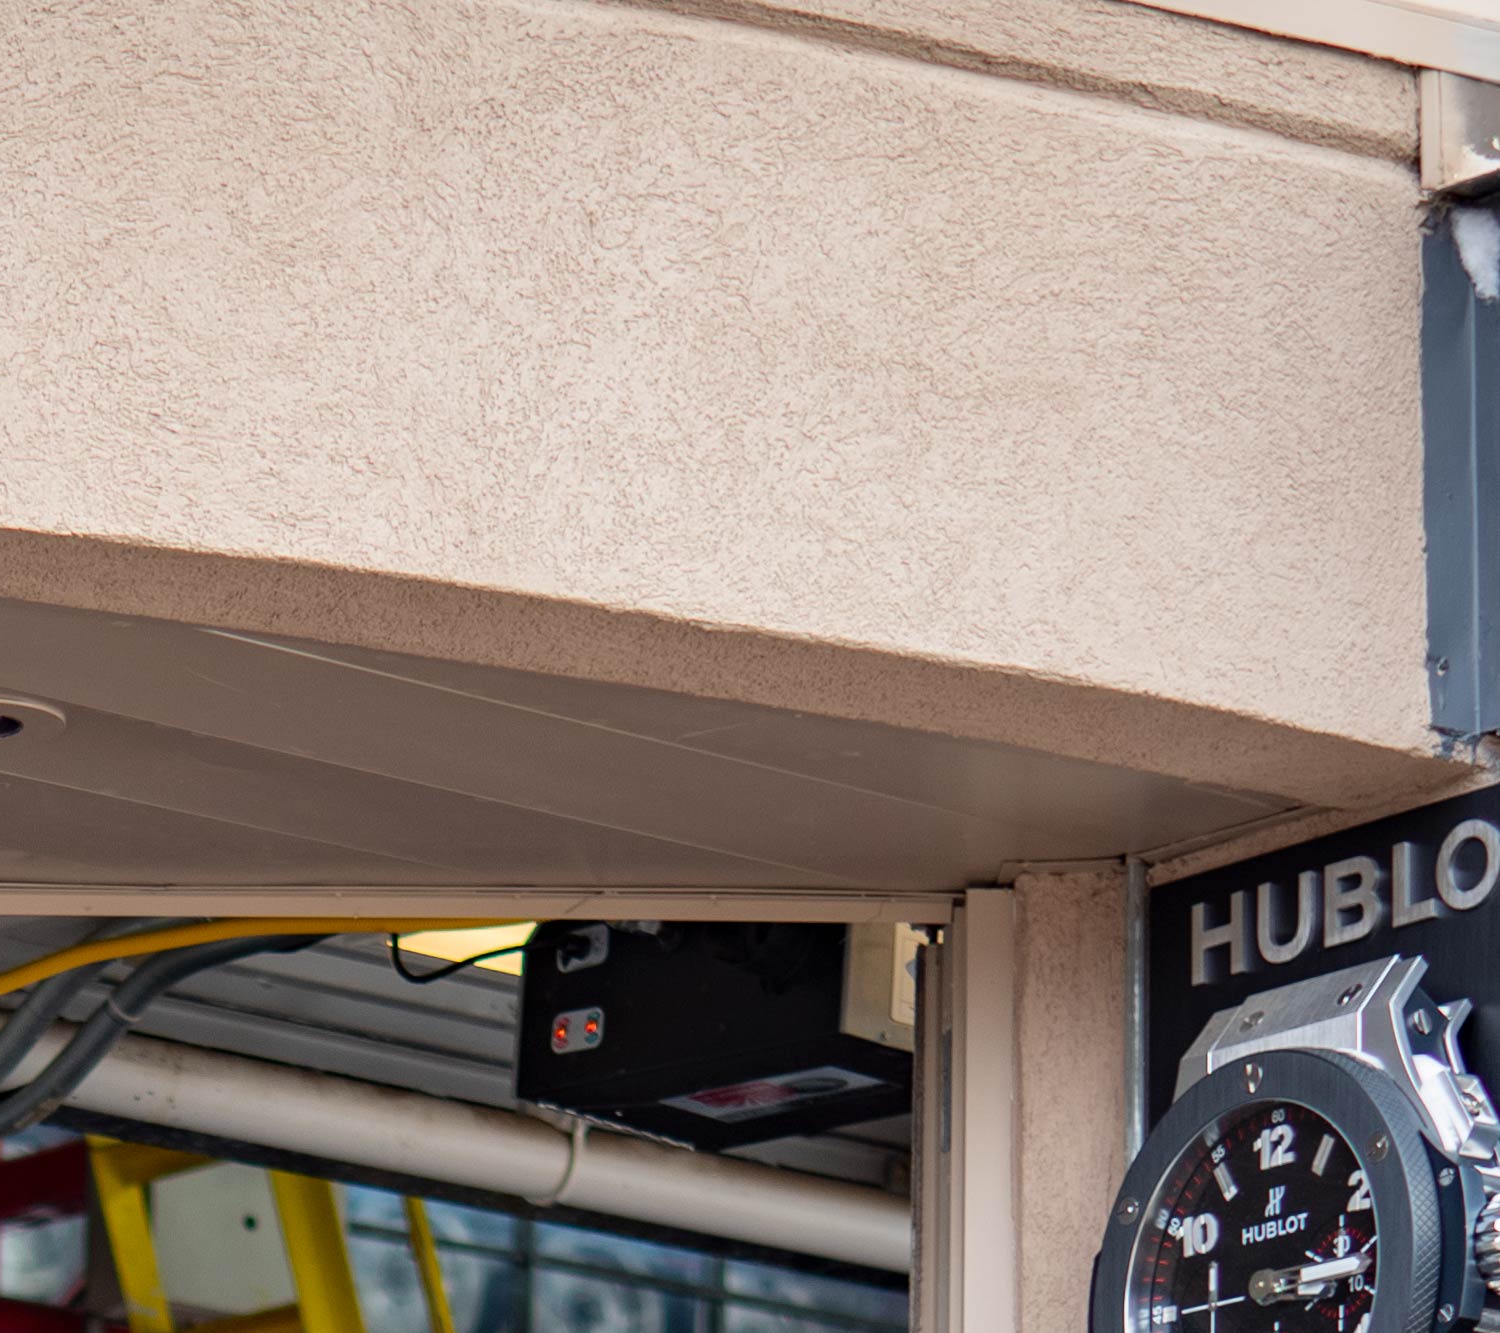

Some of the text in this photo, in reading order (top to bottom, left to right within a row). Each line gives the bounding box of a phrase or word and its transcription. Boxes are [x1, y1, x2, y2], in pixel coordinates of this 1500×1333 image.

[1253, 1124, 1296, 1171] 12
[1346, 1169, 1371, 1213] 2
[1179, 1212, 1219, 1259] 10
[1241, 1212, 1309, 1246] HUBLOT
[1349, 1276, 1364, 1292] 10
